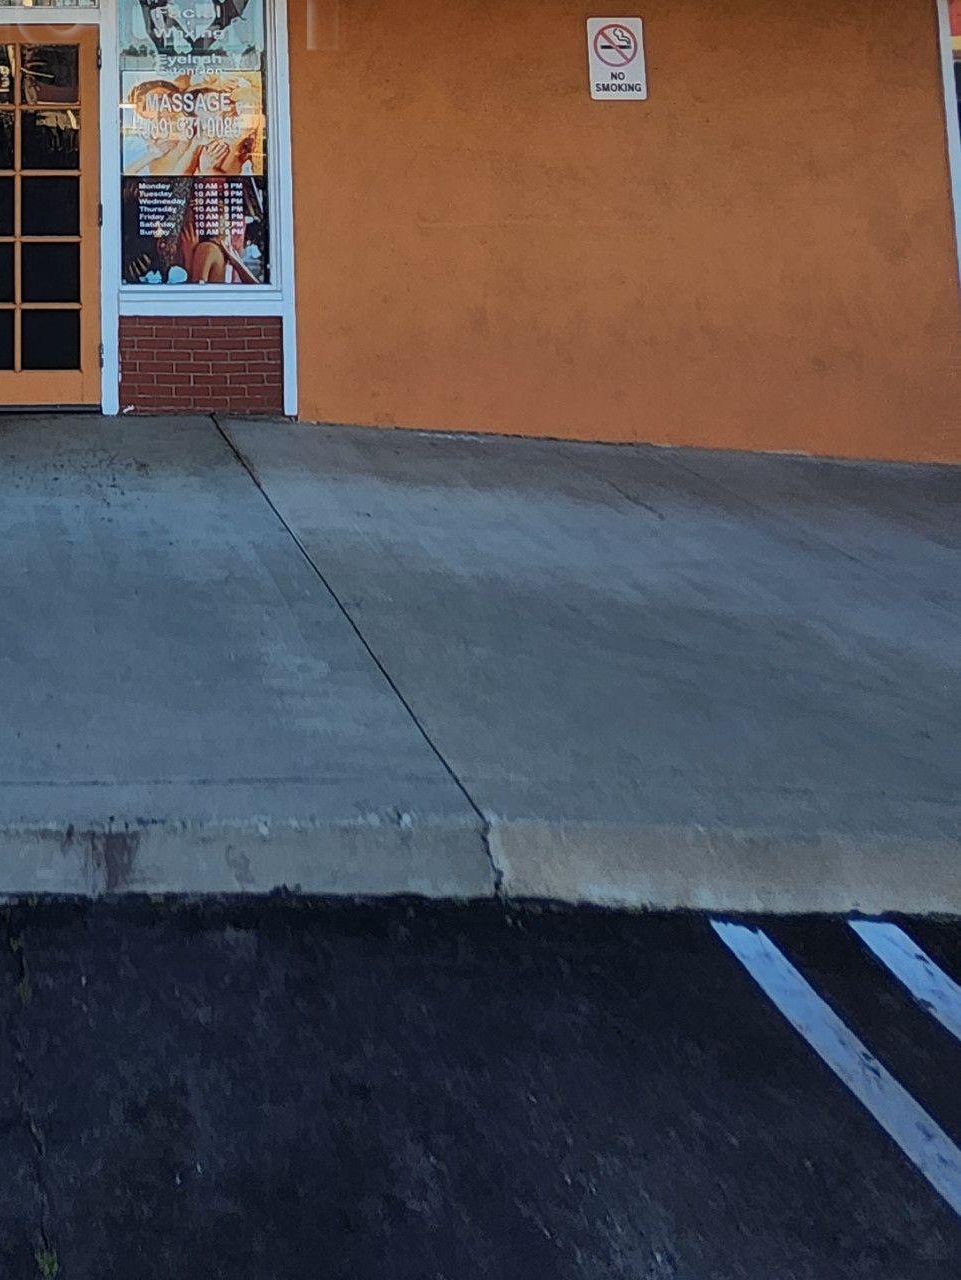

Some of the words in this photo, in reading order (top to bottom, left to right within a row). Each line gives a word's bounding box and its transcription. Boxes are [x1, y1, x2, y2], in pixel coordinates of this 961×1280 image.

[158, 53, 222, 67] Eyelash
[611, 71, 626, 81] NO
[595, 83, 642, 93] SMOKING
[145, 92, 232, 113] MASSAGE
[138, 198, 186, 206] Wednesday
[139, 221, 176, 229] Saturday
